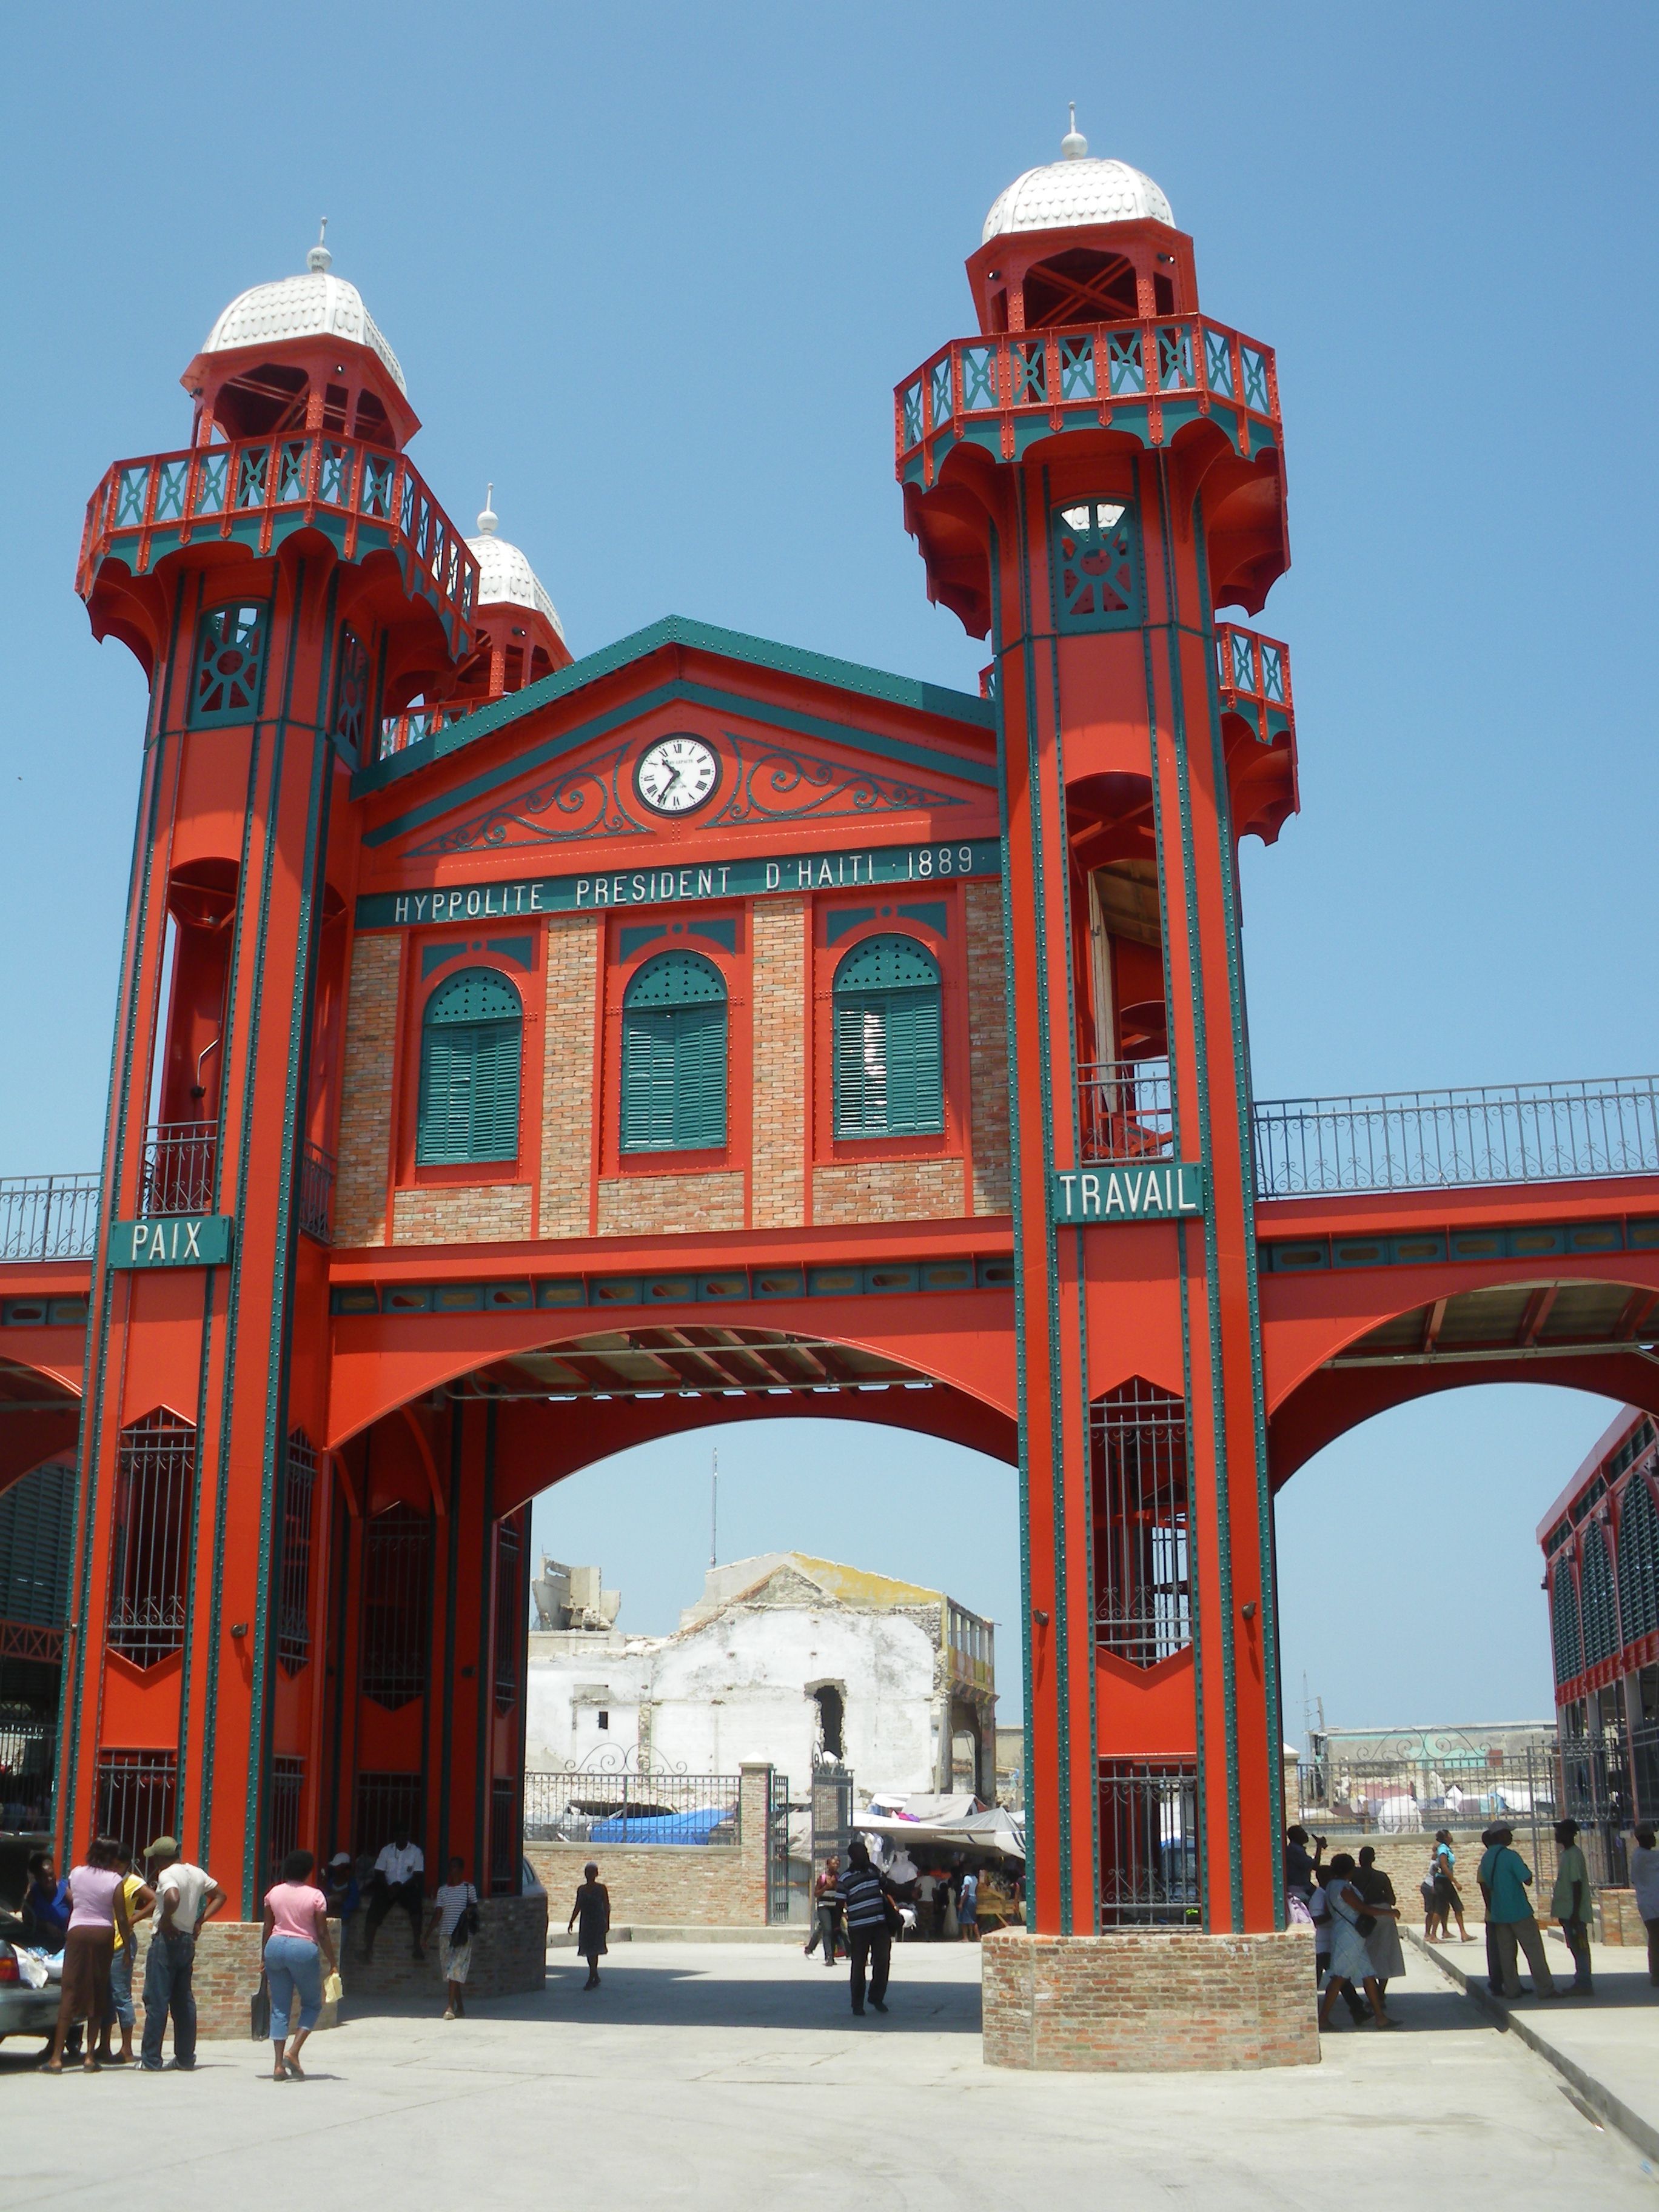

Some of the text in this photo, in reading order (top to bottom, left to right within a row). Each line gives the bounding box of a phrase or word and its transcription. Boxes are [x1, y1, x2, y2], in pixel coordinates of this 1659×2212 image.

[394, 883, 545, 923] HYPPOLITE
[576, 866, 731, 907] PRESIDENT
[908, 846, 973, 880] 1889
[1059, 1168, 1198, 1216] TRAVAIL
[132, 1221, 203, 1262] PAIX
